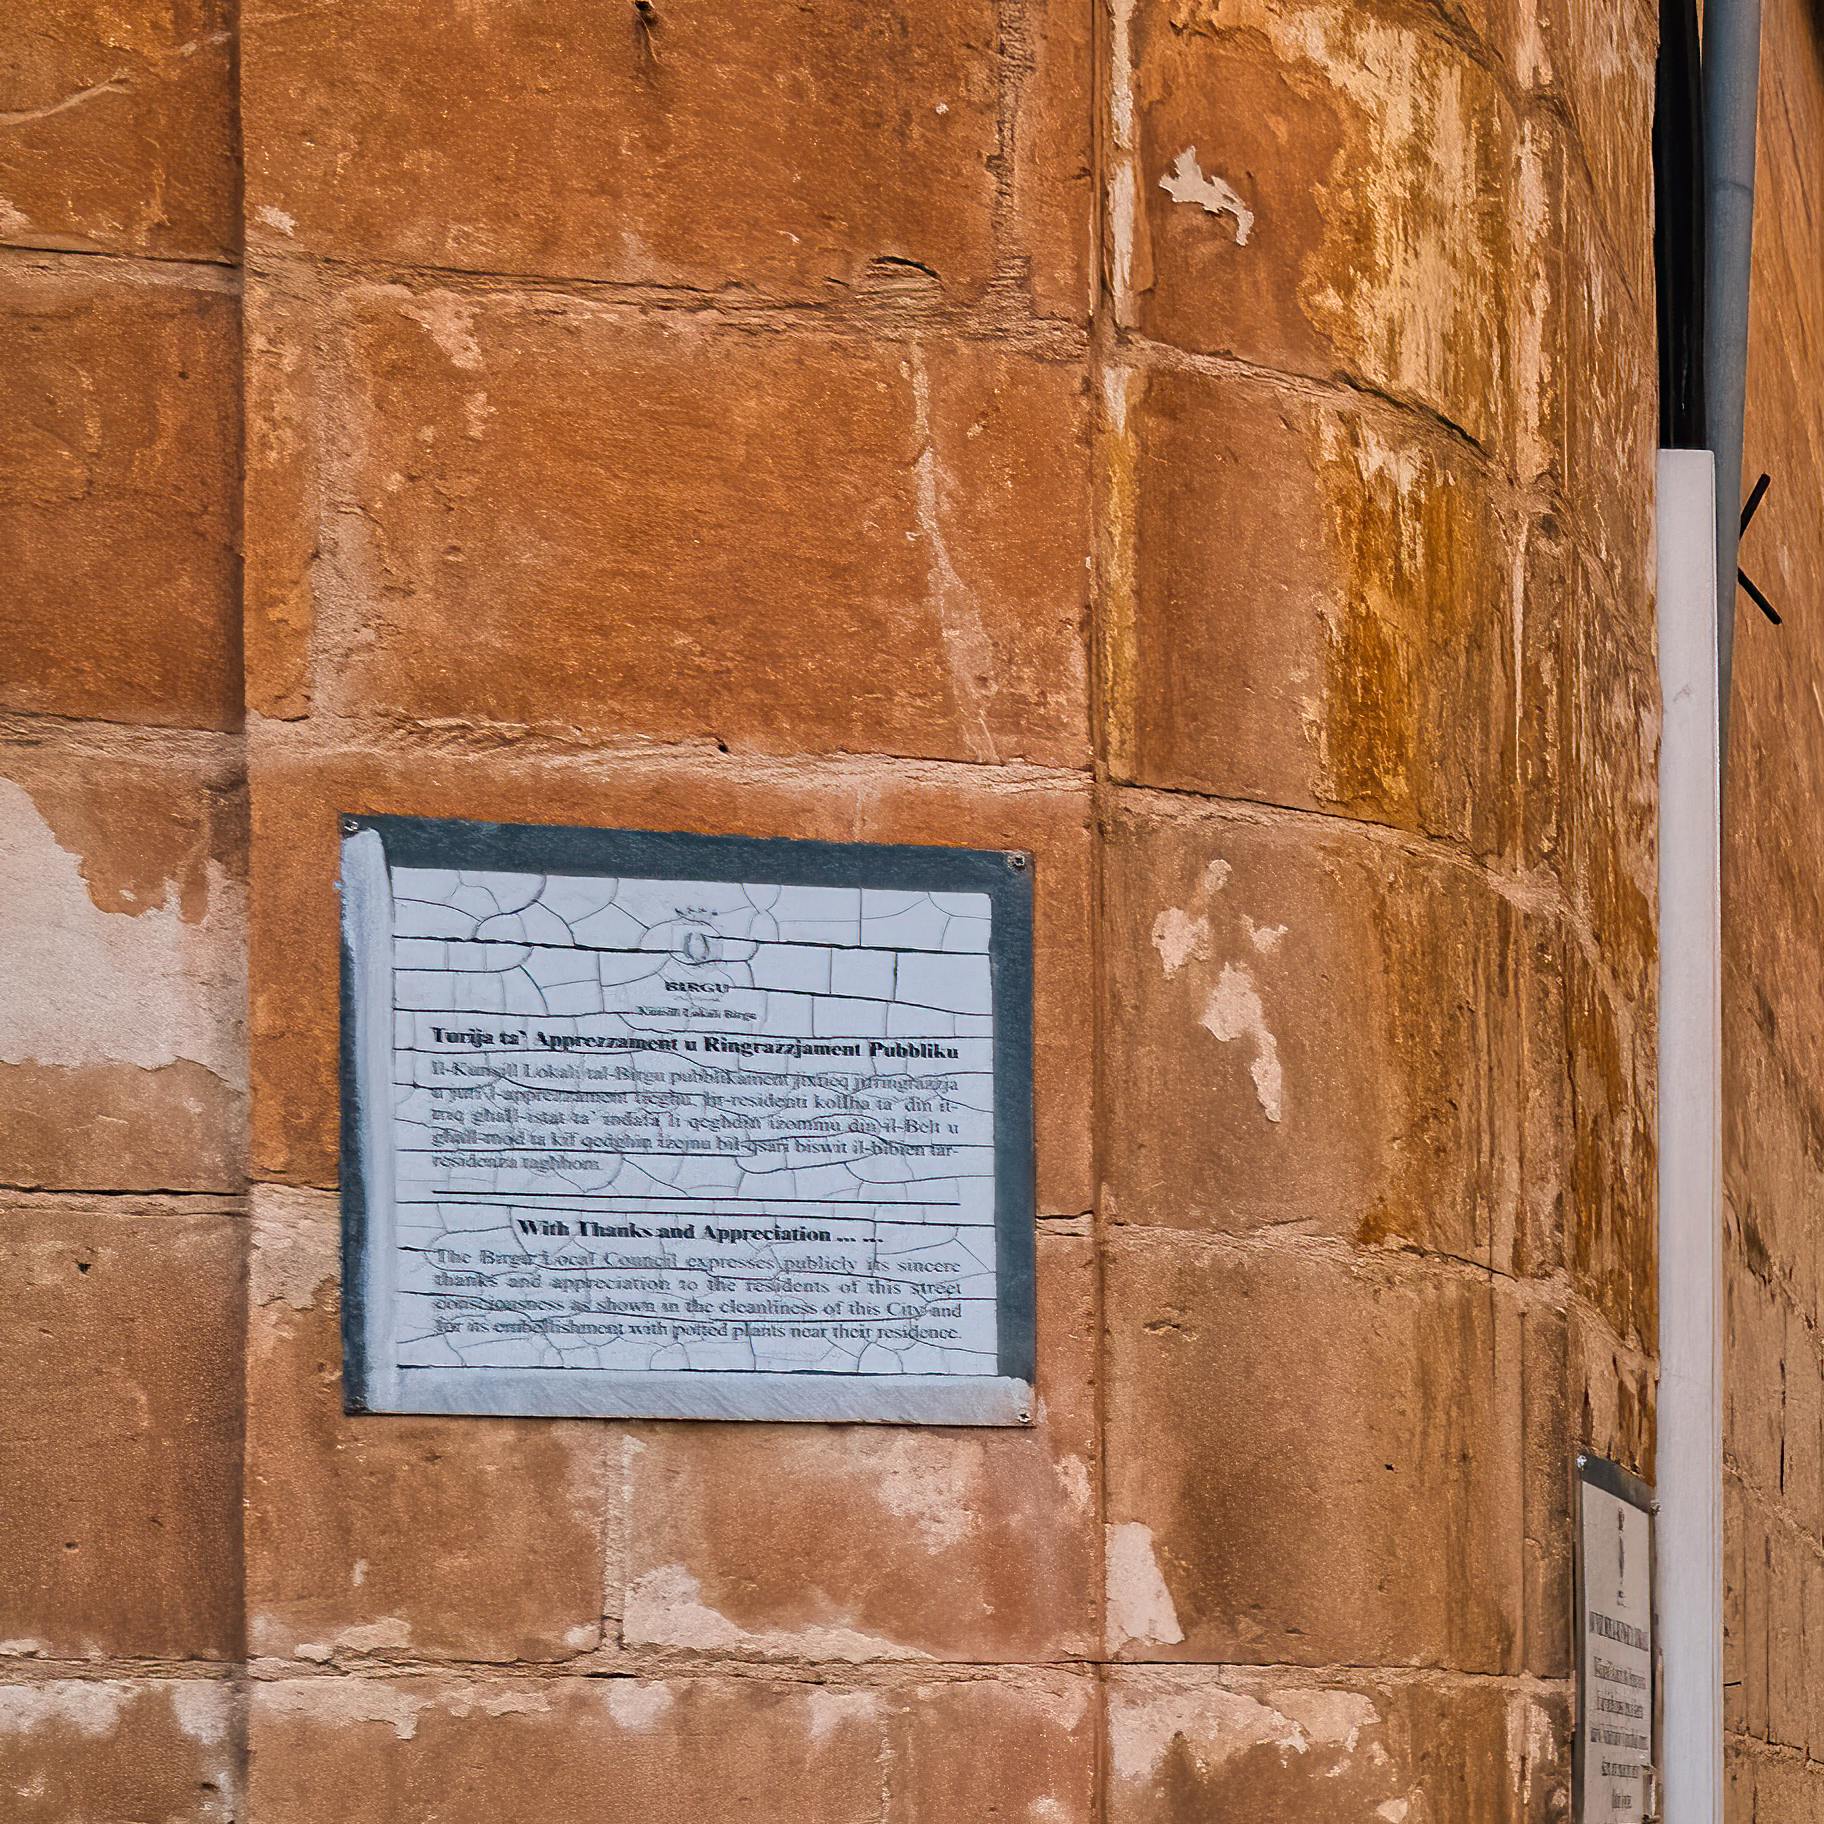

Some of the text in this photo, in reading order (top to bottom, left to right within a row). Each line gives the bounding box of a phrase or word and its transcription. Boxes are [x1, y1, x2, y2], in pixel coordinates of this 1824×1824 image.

[665, 981, 729, 993] BIRGU
[432, 1026, 495, 1048] Turija
[684, 1039, 697, 1050] u
[704, 1036, 861, 1058] Ringrazzjament
[869, 1041, 959, 1059] Pubbliku
[904, 1096, 932, 1112] din
[947, 1124, 958, 1134] u
[517, 1218, 571, 1236] With
[577, 1220, 653, 1239] Thanks
[656, 1223, 695, 1239] and
[704, 1224, 831, 1245] Appreciation
[437, 1249, 472, 1264] The
[603, 1252, 678, 1268] Council
[686, 1257, 775, 1274] expresses
[783, 1254, 856, 1272] publicly
[897, 1257, 961, 1273] sincere
[432, 1272, 961, 1296] thanks and appreciation to the residents of this street
[596, 1296, 655, 1313] shown
[686, 1297, 713, 1314] the
[718, 1298, 817, 1316] cleanliness
[823, 1300, 842, 1316] of
[850, 1300, 881, 1317] this
[886, 1302, 926, 1319] City
[931, 1303, 961, 1319] and
[628, 1321, 667, 1336] with
[672, 1322, 727, 1341] potted
[733, 1323, 785, 1341] plants
[790, 1326, 828, 1338] near
[832, 1322, 873, 1339] their
[877, 1324, 962, 1340] residence.
